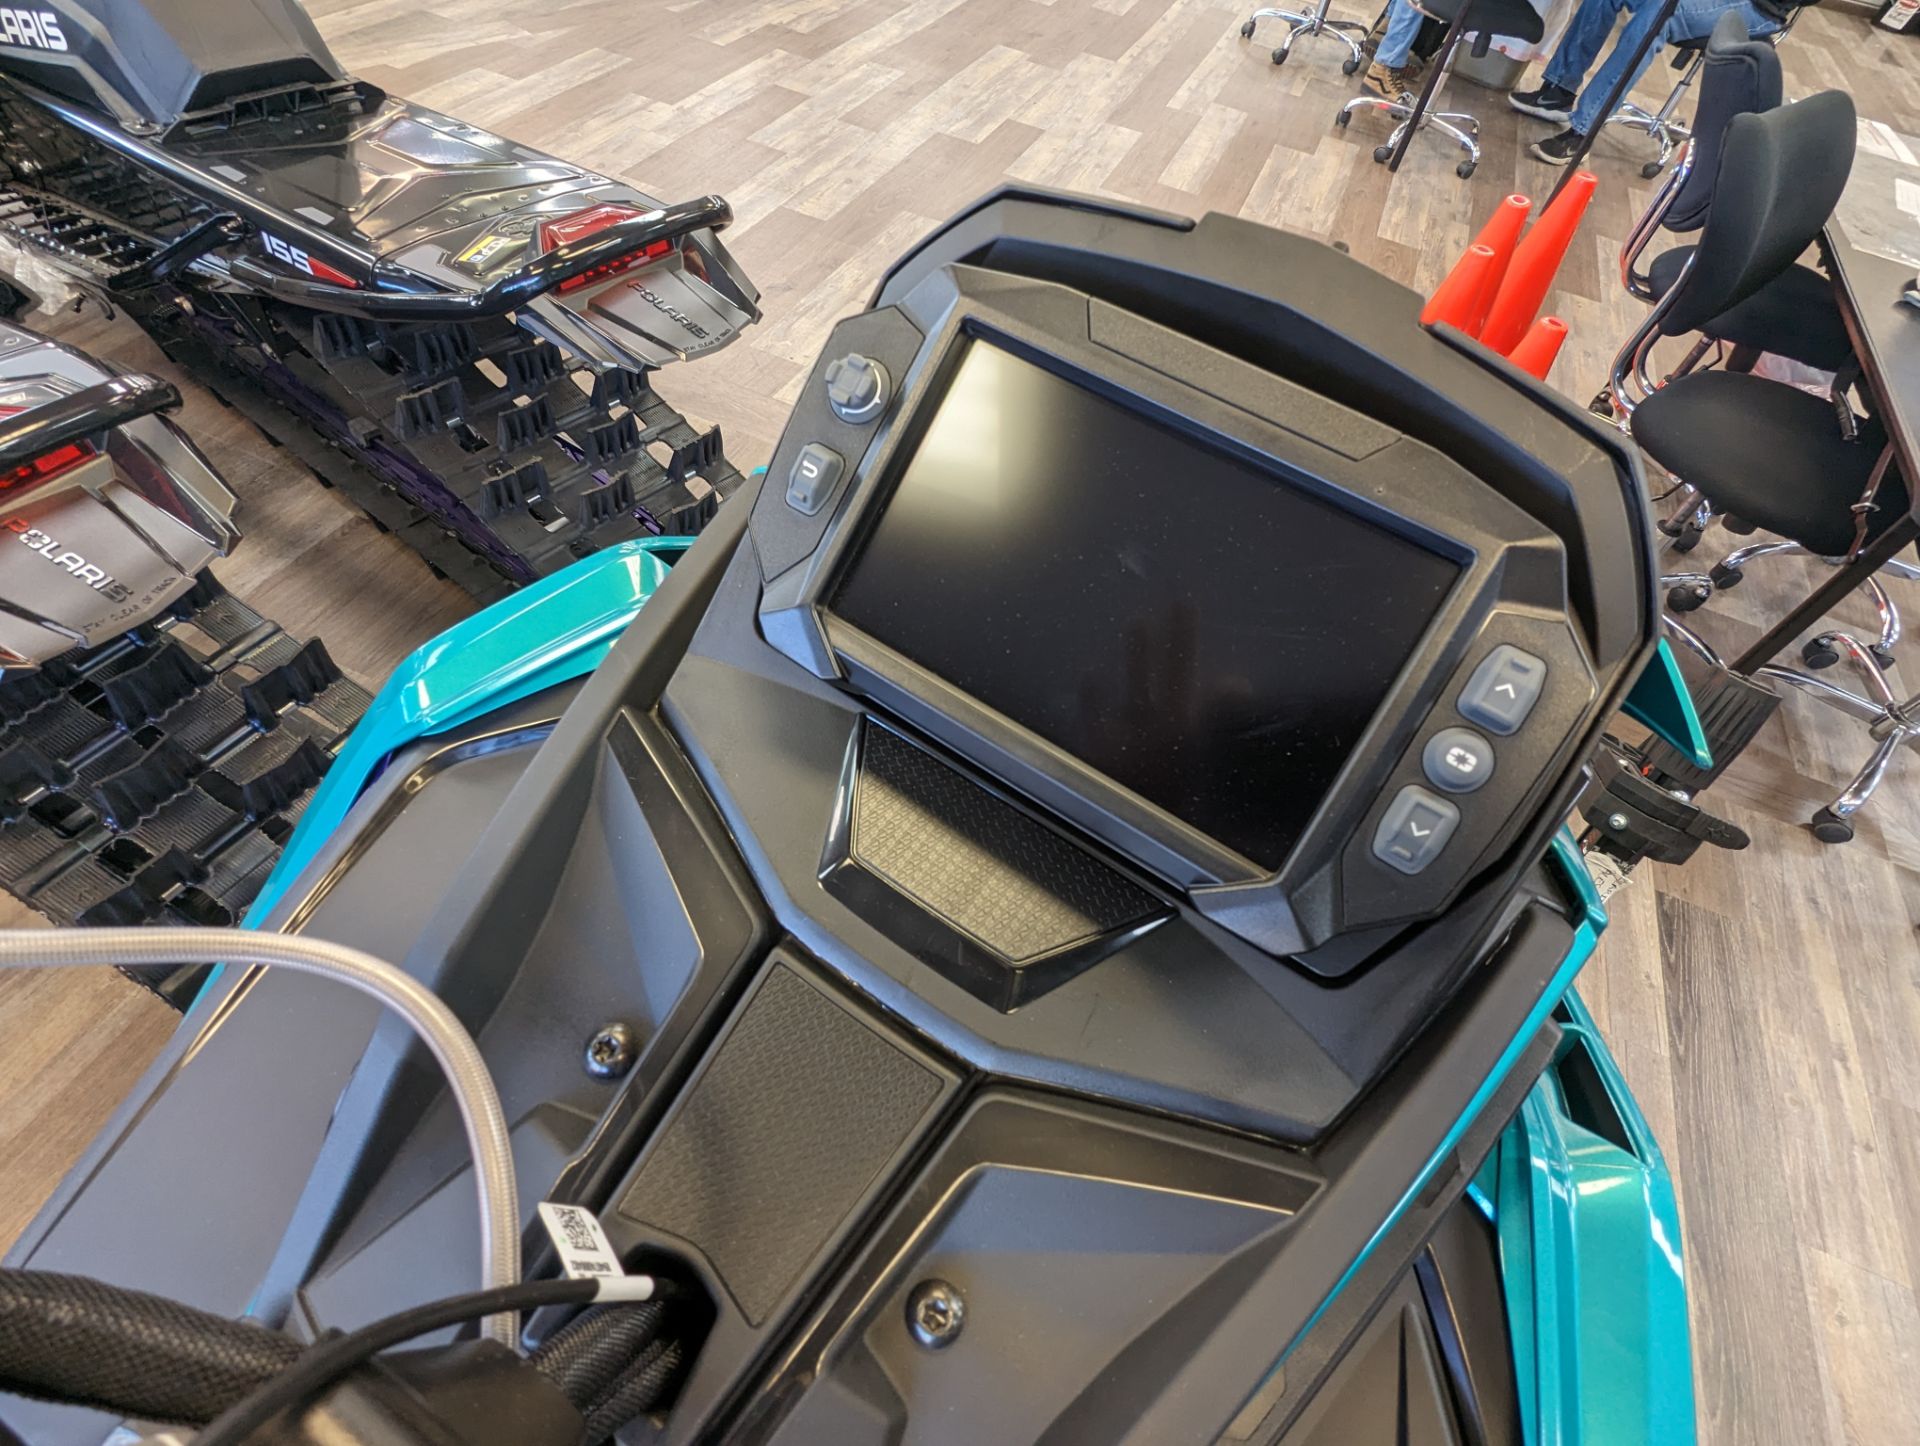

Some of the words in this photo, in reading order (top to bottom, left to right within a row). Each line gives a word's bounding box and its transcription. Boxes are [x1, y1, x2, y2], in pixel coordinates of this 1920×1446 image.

[261, 230, 315, 276] 155
[626, 280, 710, 339] POLARIS
[0, 516, 134, 603] POLARIS
[110, 604, 141, 621] CLEAR
[142, 595, 153, 604] OF
